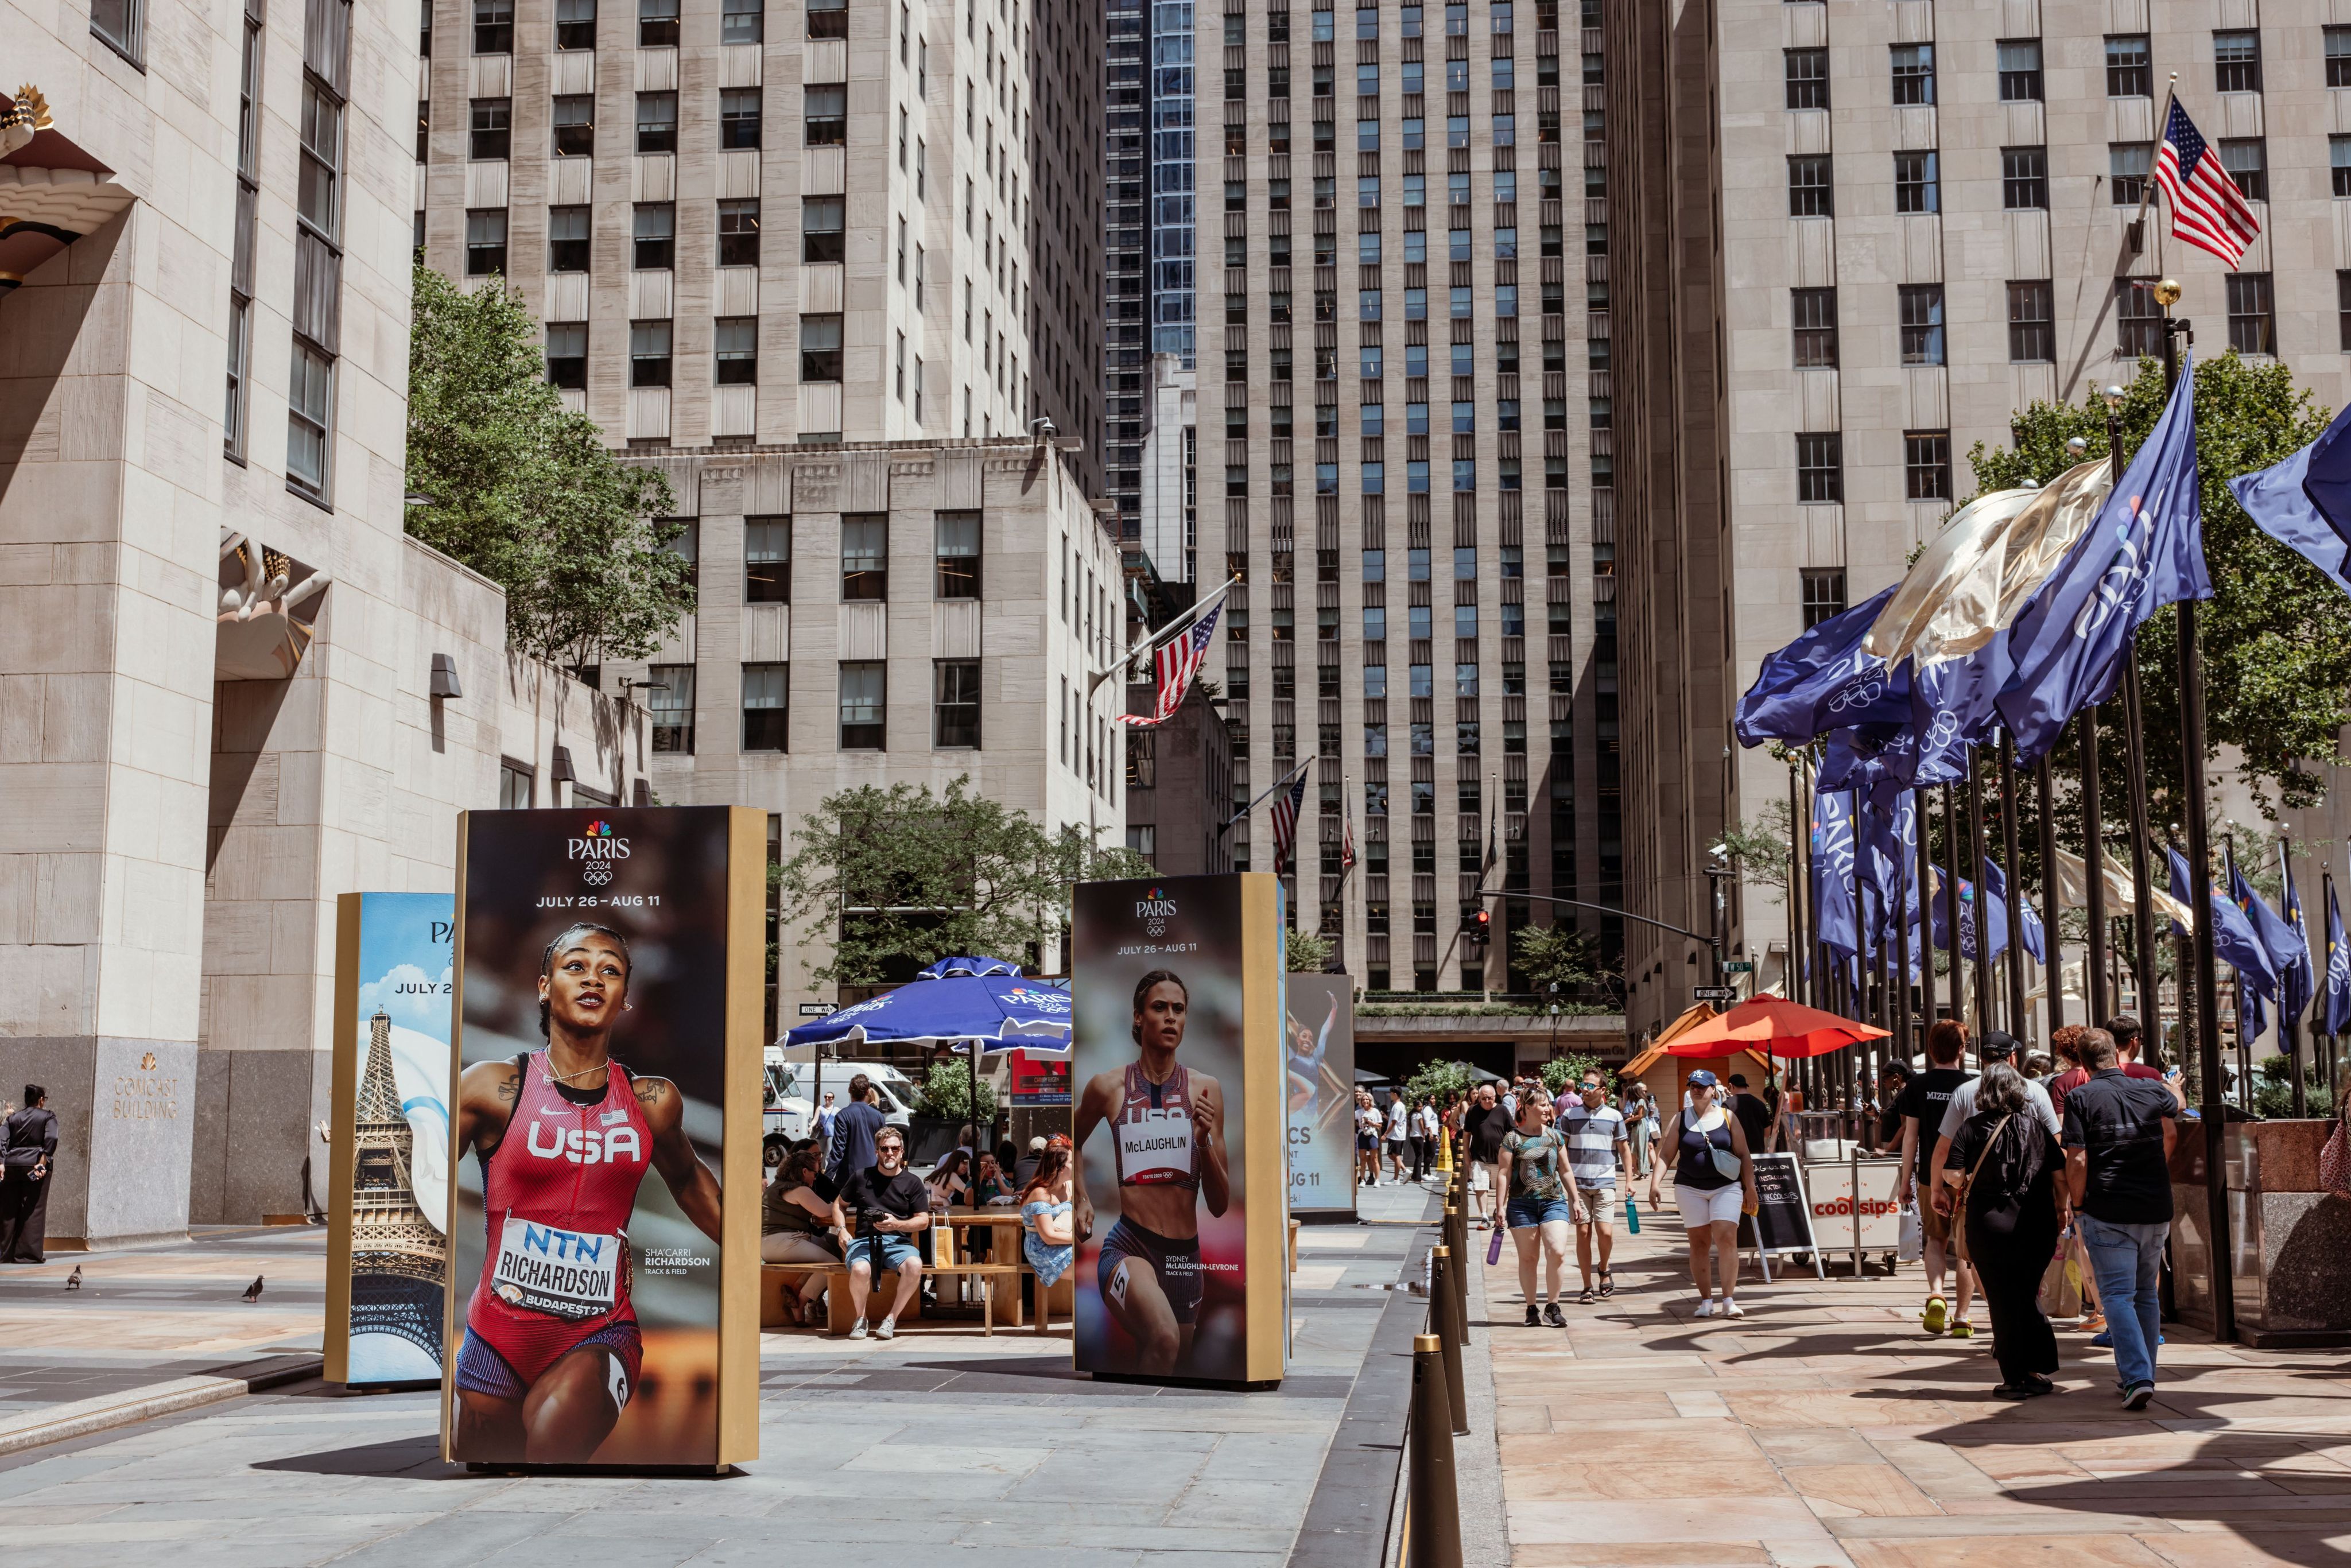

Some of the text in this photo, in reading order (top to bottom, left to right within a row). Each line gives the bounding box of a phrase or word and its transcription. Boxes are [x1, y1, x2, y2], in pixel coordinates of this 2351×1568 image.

[568, 838, 630, 859] PARIS
[585, 861, 611, 870] 2024
[536, 896, 574, 907] JULY
[578, 896, 598, 907] 26
[611, 895, 643, 906] AUG
[647, 895, 659, 906] 11
[1136, 899, 1177, 918] PARIS
[1118, 945, 1142, 955] JULY
[1144, 945, 1157, 953] 26
[1165, 944, 1186, 953] AUG
[1189, 943, 1197, 951] 11
[395, 983, 437, 994] JULY
[998, 993, 1072, 1004] PARIS
[115, 1077, 178, 1097] COMCAST
[113, 1101, 177, 1119] BUILDING
[526, 1121, 641, 1164] USA
[1125, 1136, 1186, 1154] McLAUGHLIN
[1309, 1173, 1319, 1186] 11
[523, 1223, 603, 1264] NTN
[645, 1257, 710, 1266] RICHARDSON
[1166, 1263, 1239, 1271] McLAUGHLIN-LEVRONE
[500, 1250, 611, 1297] RICHARDSON
[1114, 1272, 1127, 1298] 5
